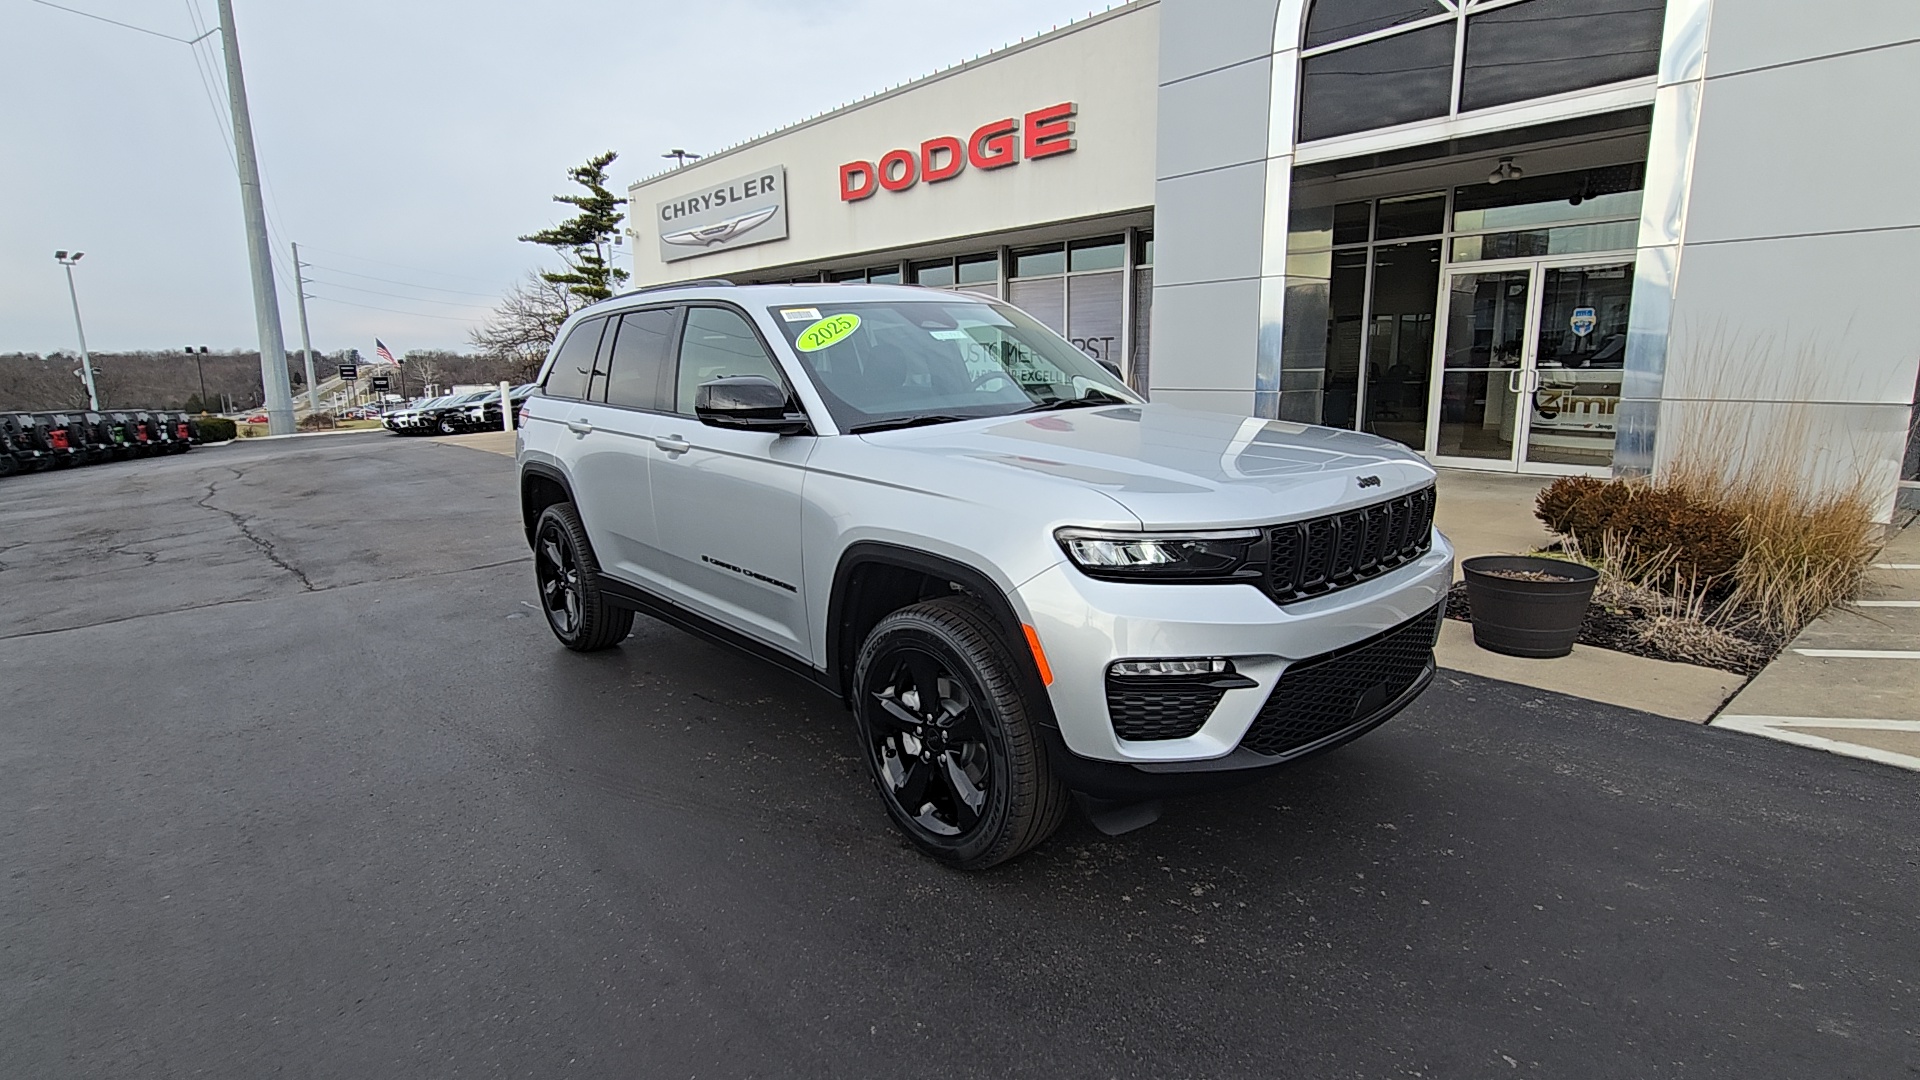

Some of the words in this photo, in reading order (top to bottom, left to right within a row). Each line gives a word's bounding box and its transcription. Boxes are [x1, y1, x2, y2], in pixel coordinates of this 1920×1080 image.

[840, 101, 1077, 203] DODGE
[661, 174, 776, 222] CHRYSLER
[808, 317, 853, 347] 2025
[1355, 475, 1382, 489] Jeep
